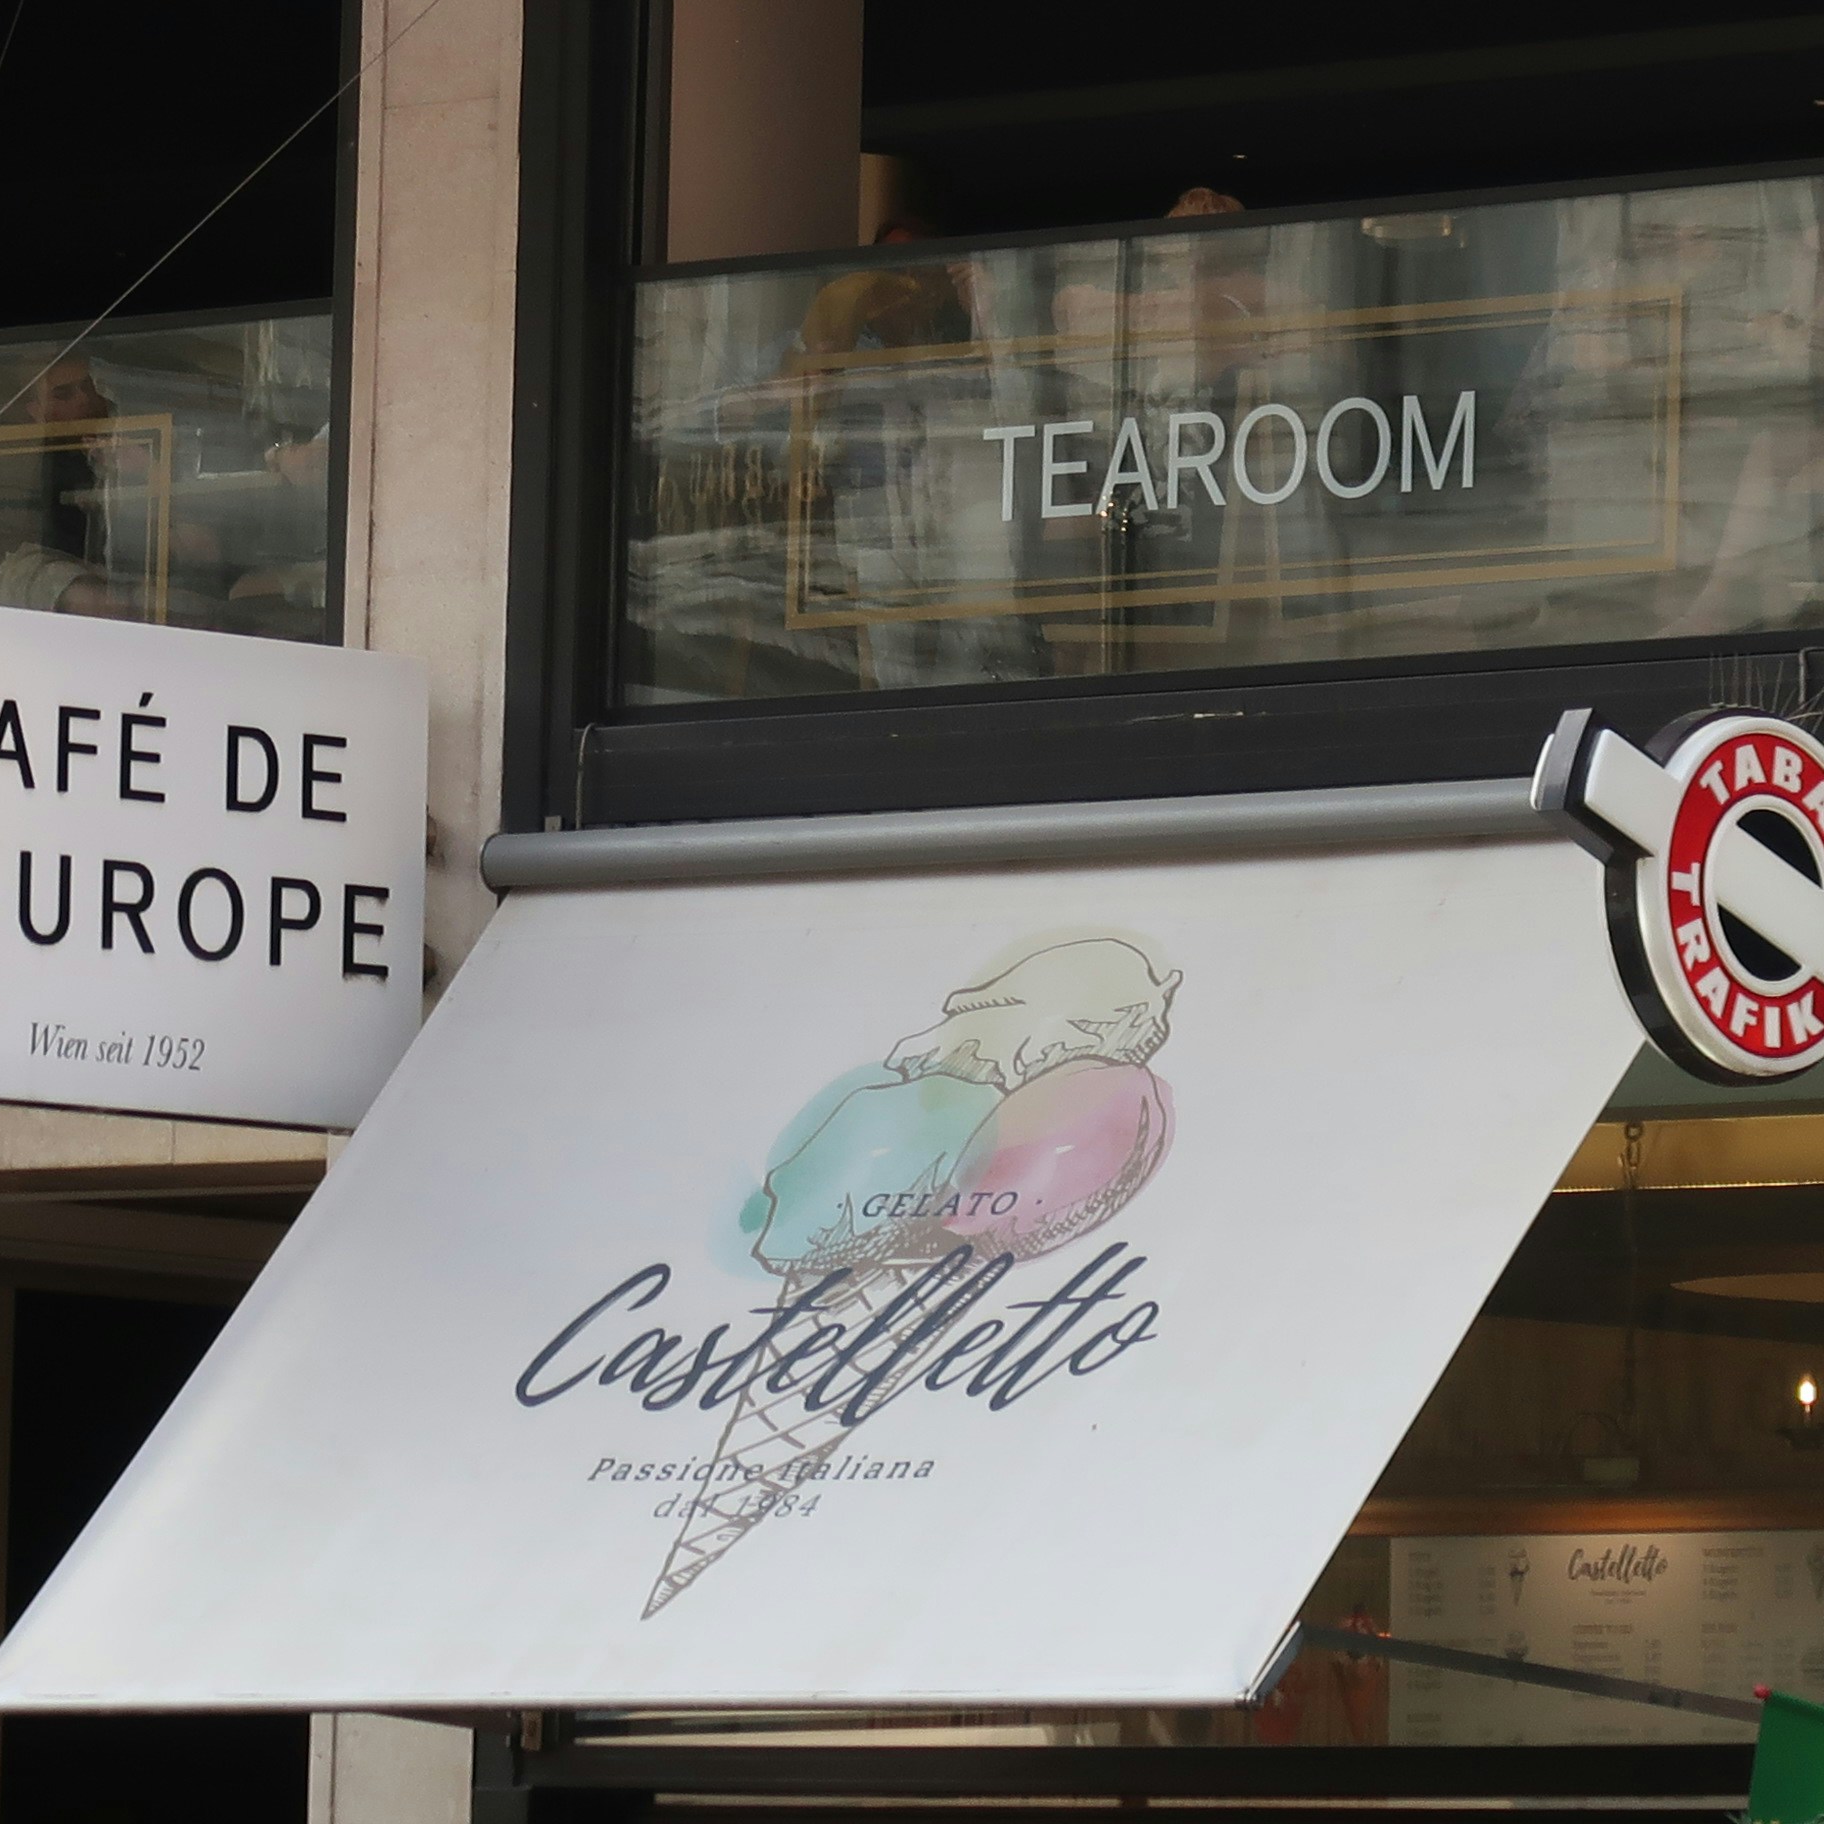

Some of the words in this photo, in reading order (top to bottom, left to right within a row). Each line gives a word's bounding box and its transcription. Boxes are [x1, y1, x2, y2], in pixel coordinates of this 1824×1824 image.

[983, 390, 1476, 521] TEAROOM
[225, 724, 348, 823] DE
[30, 1022, 88, 1060] Wien
[95, 1031, 134, 1064] seit
[142, 1034, 206, 1072] 1952
[861, 1189, 1020, 1219] GELATO
[514, 1240, 1161, 1428] Castelletto
[586, 1456, 765, 1482] Passione
[652, 1492, 720, 1519] dal
[733, 1492, 823, 1519] 1984
[1567, 1543, 1669, 1584] Castelletto
